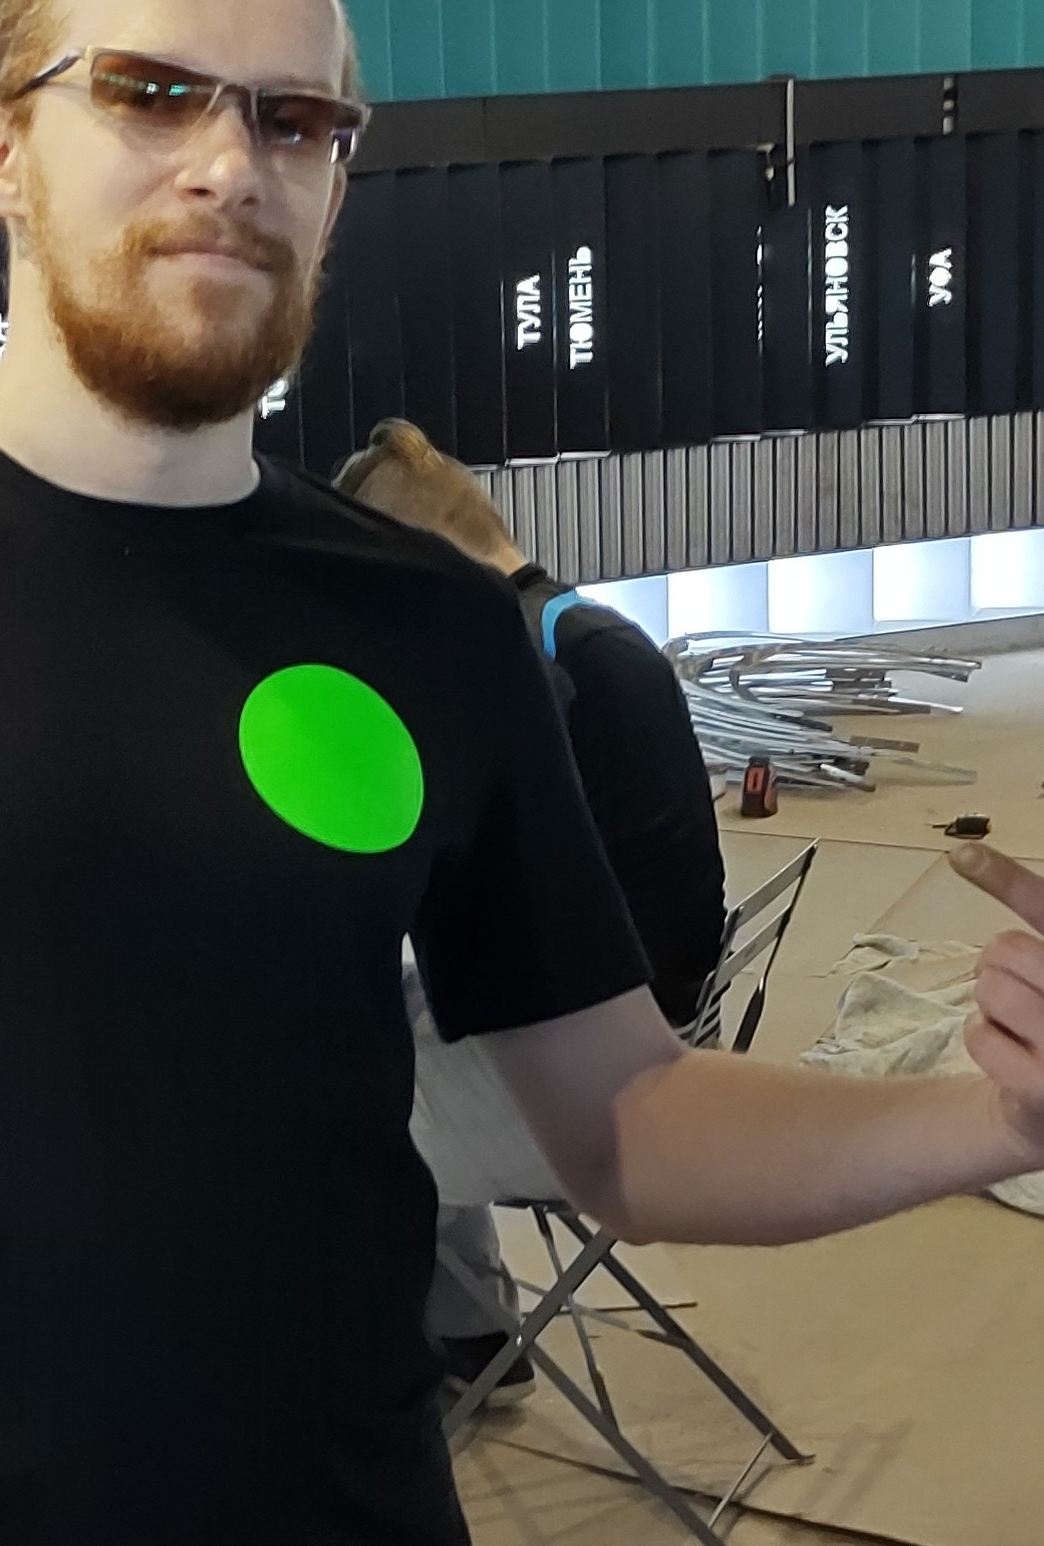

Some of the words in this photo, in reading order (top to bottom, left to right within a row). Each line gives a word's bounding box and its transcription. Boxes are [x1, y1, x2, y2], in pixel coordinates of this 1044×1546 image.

[516, 273, 541, 350] ТУЛА
[568, 246, 593, 370] ТЮМЕНЬ
[825, 205, 849, 367] УЛЬЯНОВСК
[928, 248, 953, 307] УФА
